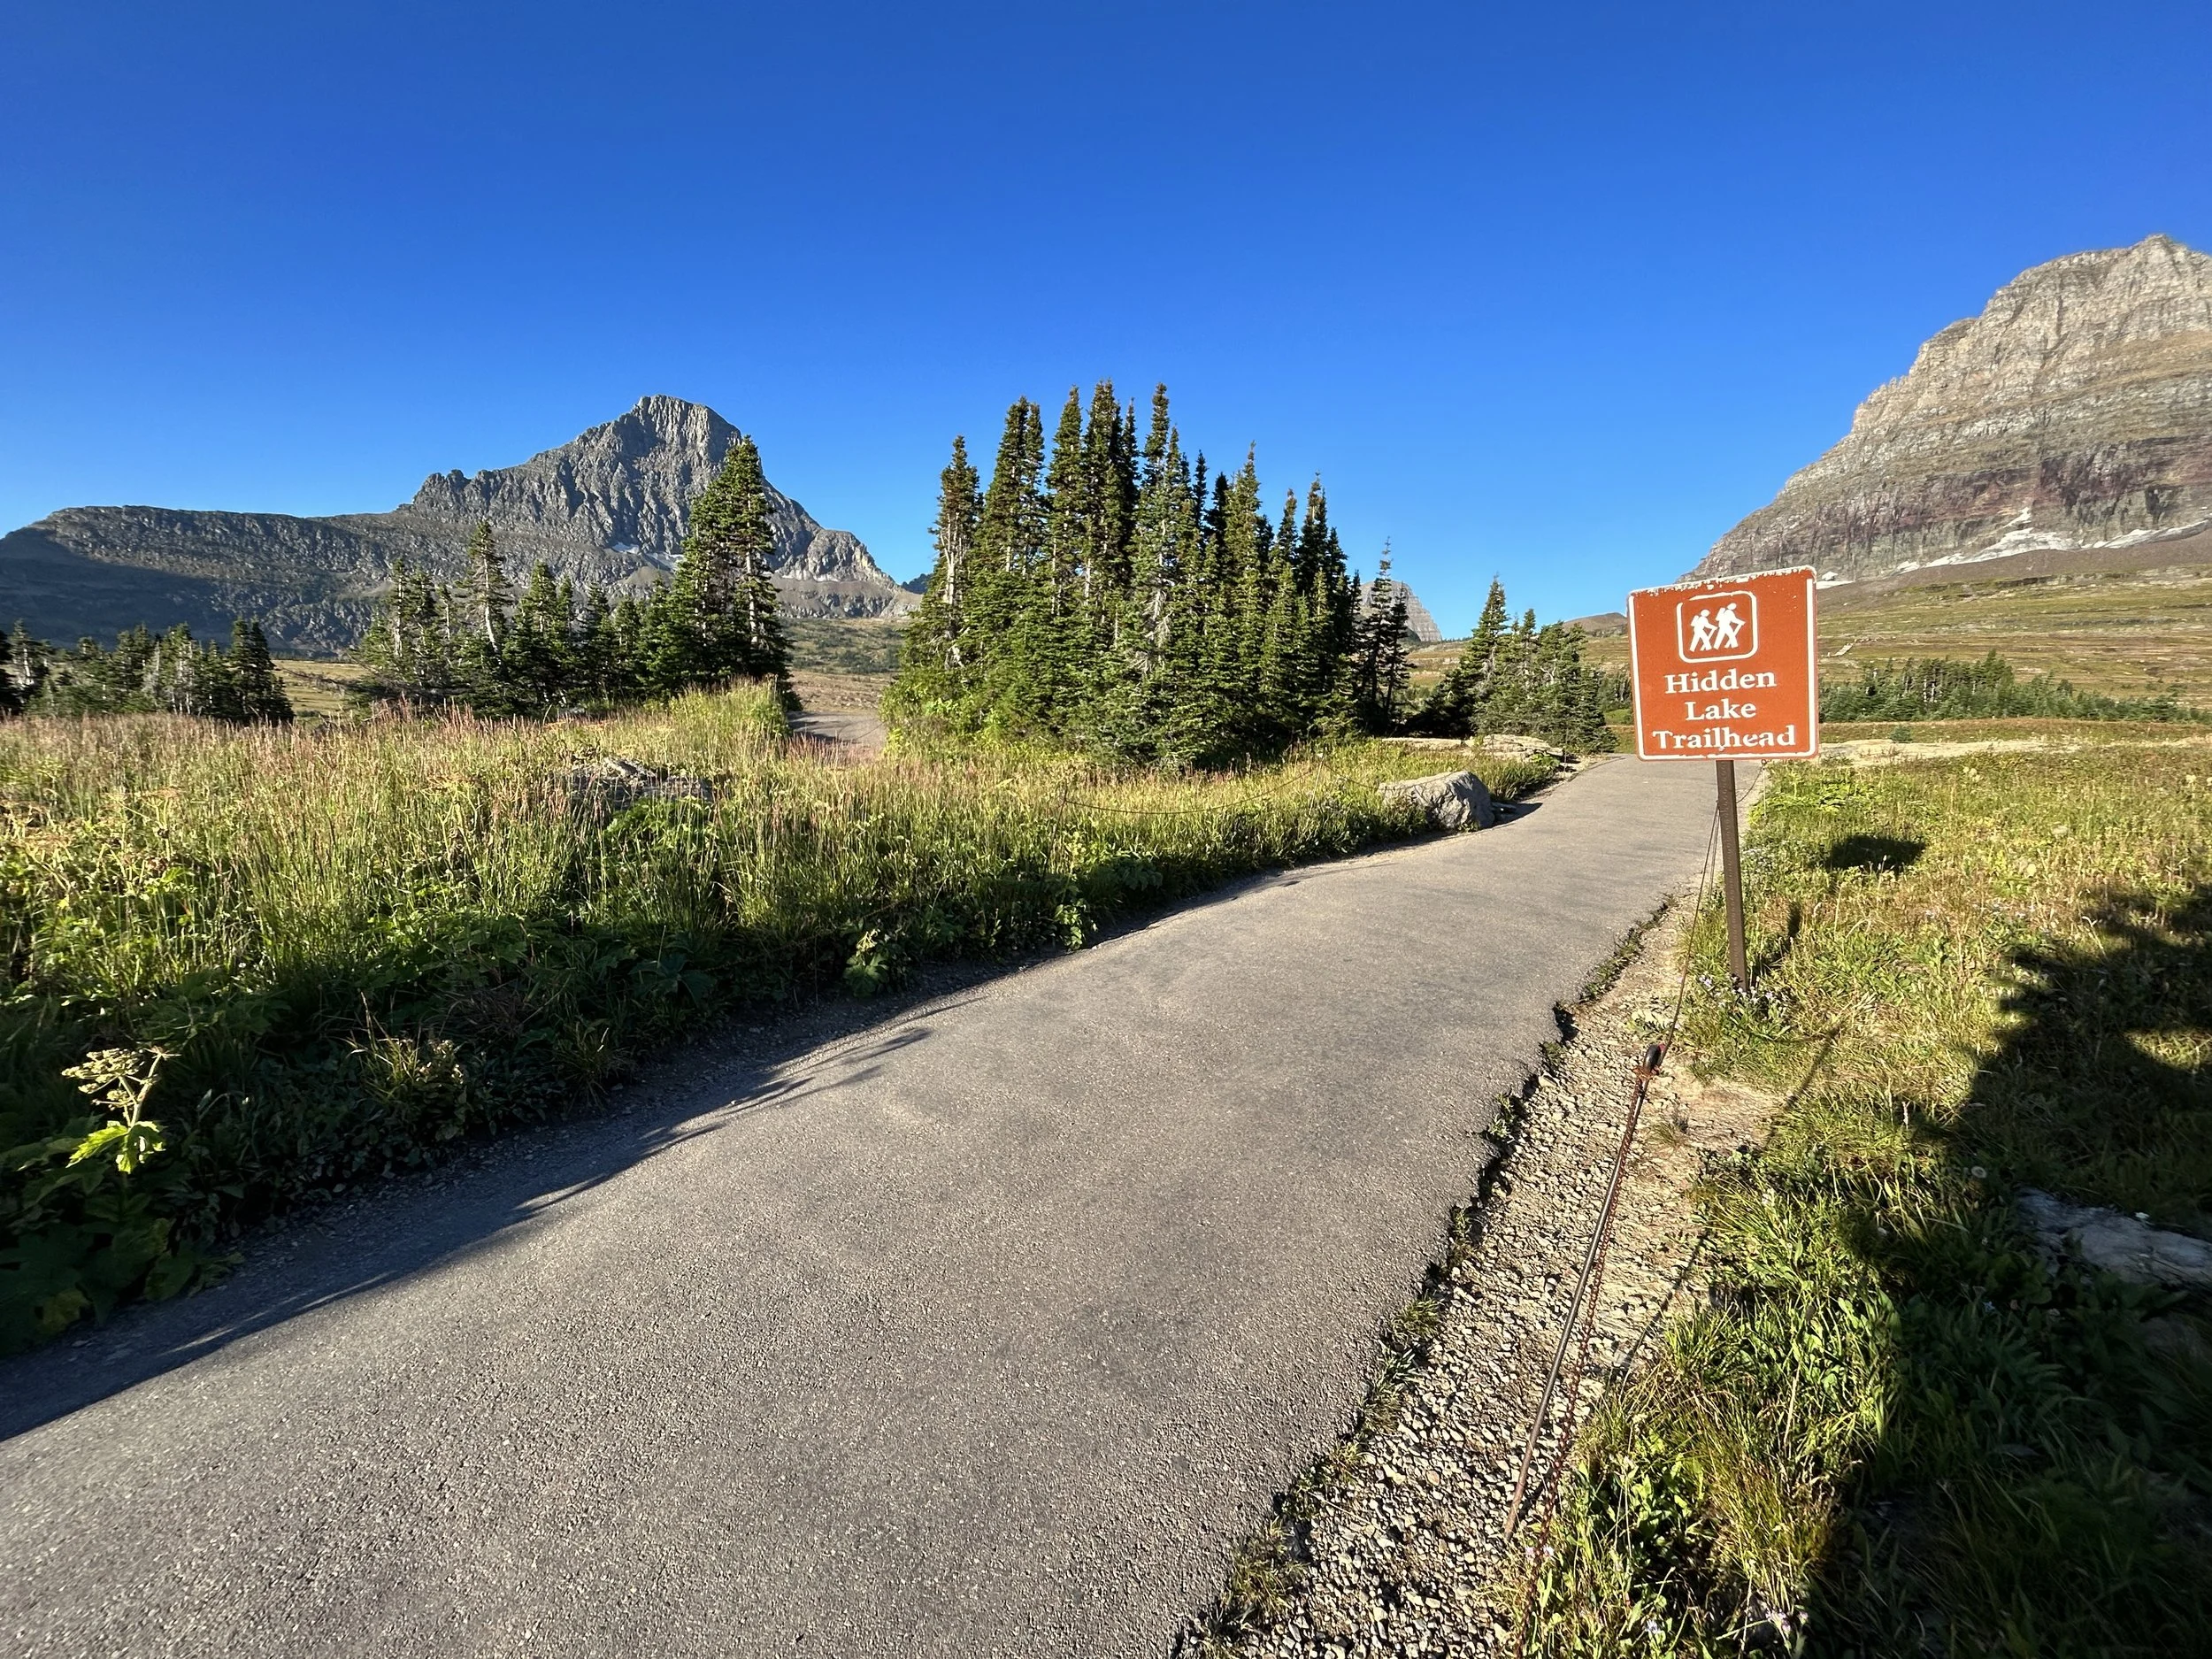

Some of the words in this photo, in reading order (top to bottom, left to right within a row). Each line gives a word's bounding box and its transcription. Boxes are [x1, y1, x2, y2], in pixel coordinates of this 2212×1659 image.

[1663, 668, 1778, 695] Hidden
[1684, 698, 1757, 721] Lake
[1652, 725, 1796, 749] Trailhead
